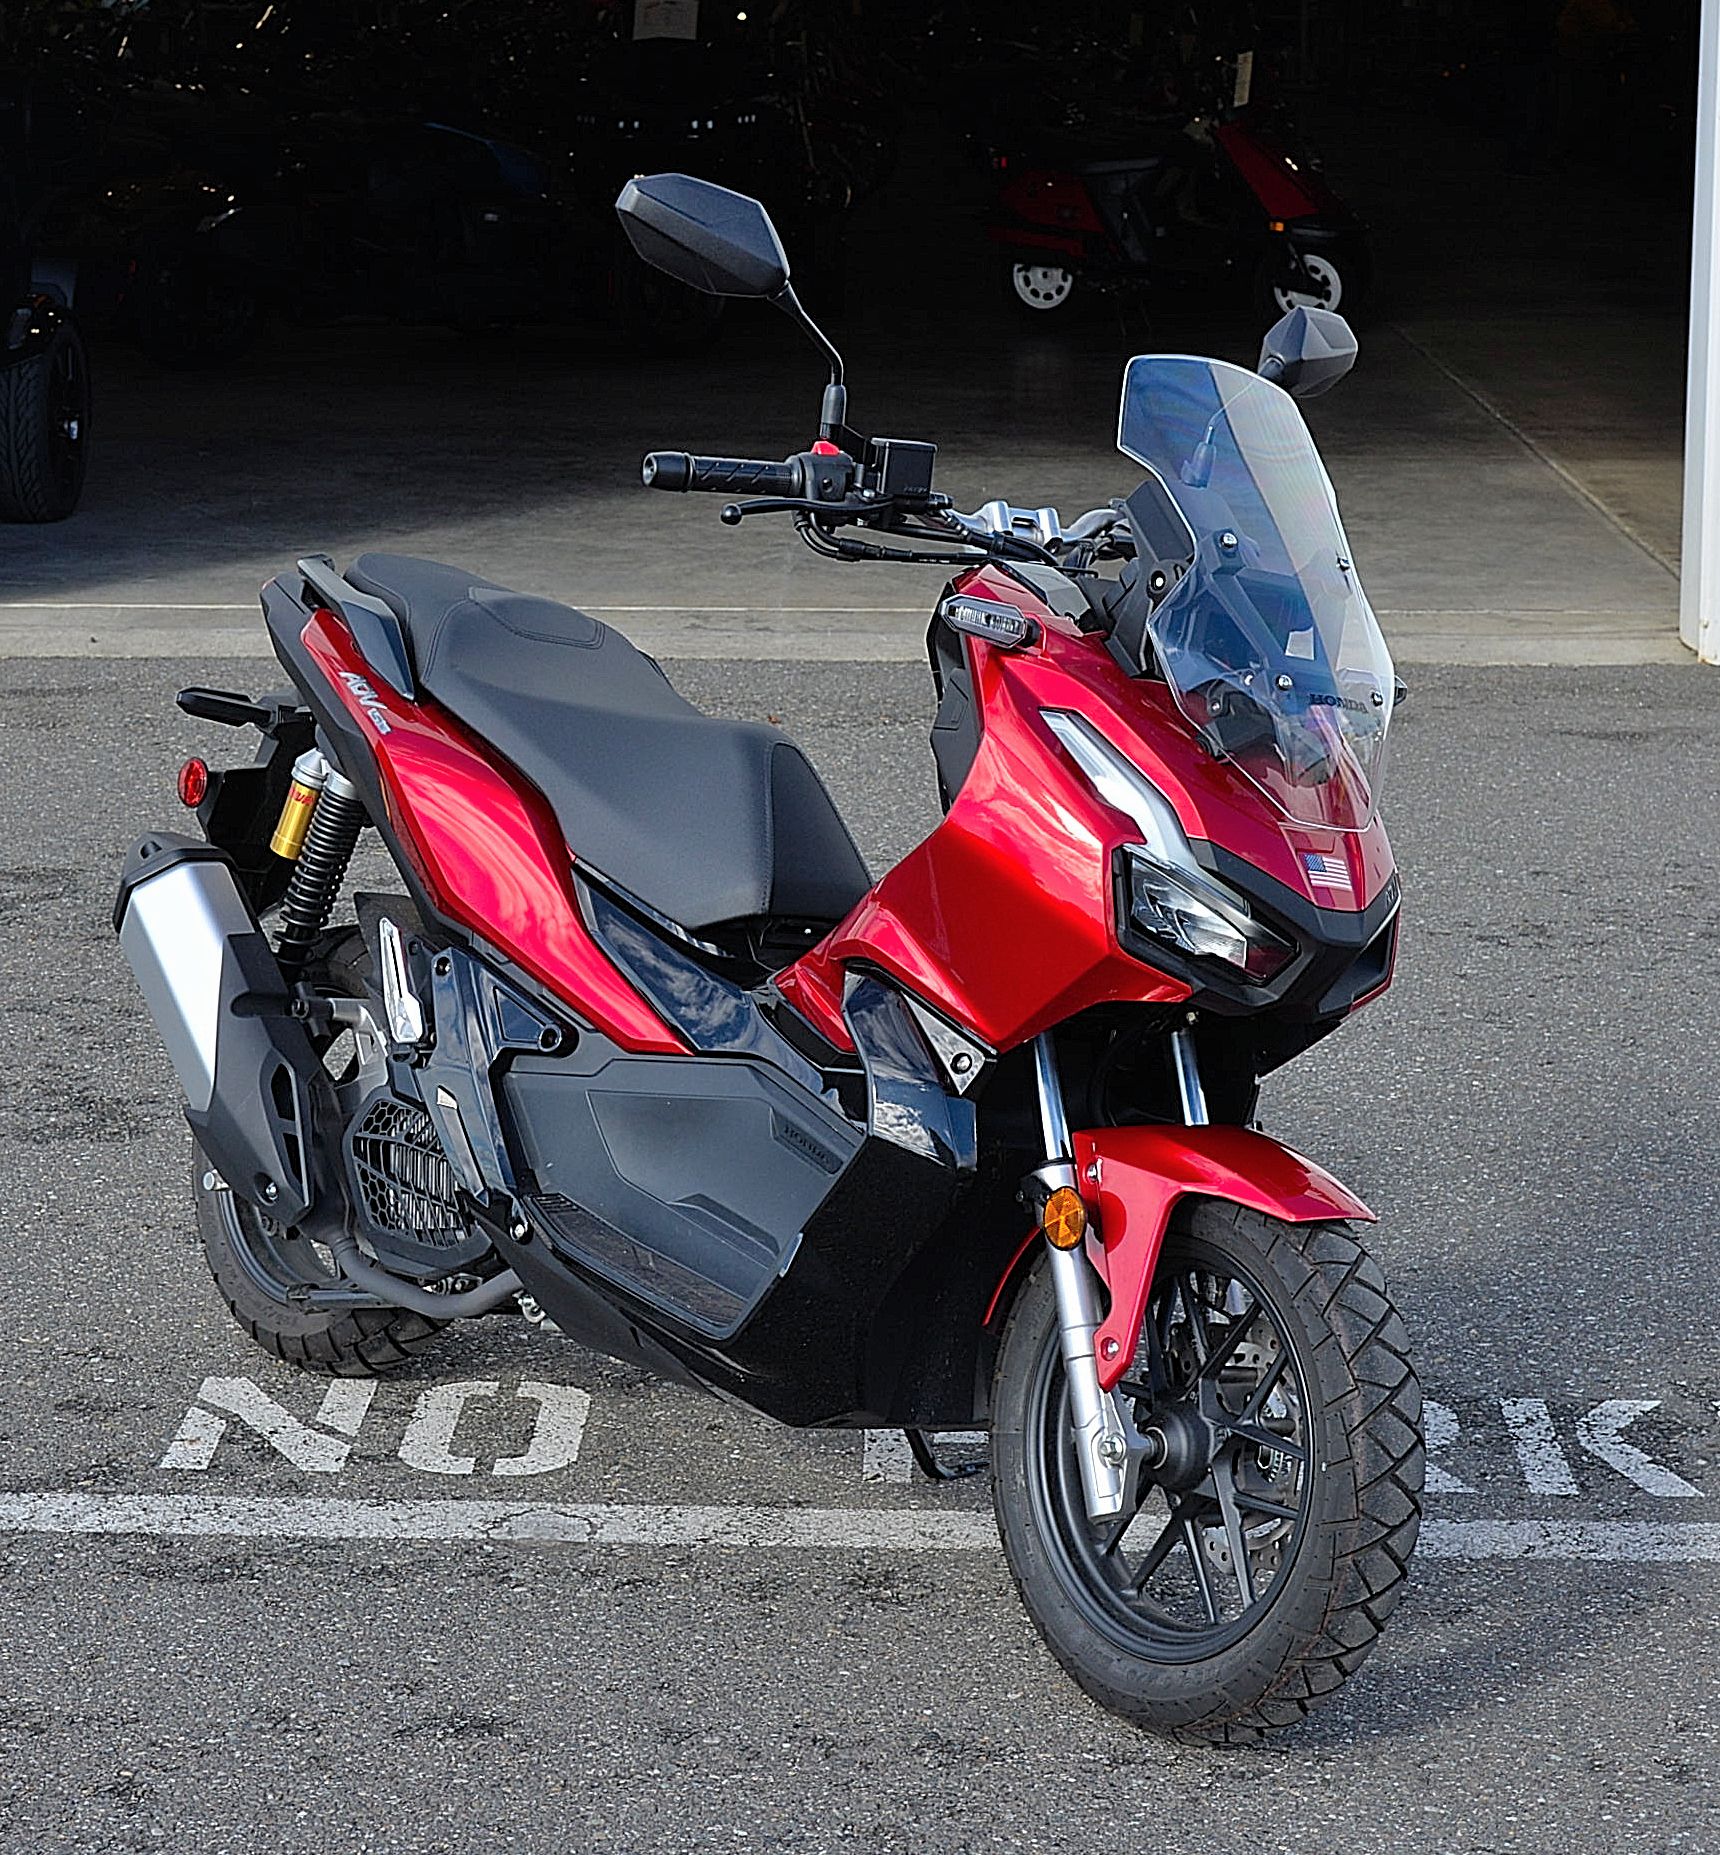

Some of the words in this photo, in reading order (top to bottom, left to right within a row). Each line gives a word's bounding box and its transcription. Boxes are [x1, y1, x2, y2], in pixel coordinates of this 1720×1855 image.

[338, 671, 388, 710] ADV
[1309, 693, 1369, 714] HONDA
[159, 1376, 591, 1476] NO
